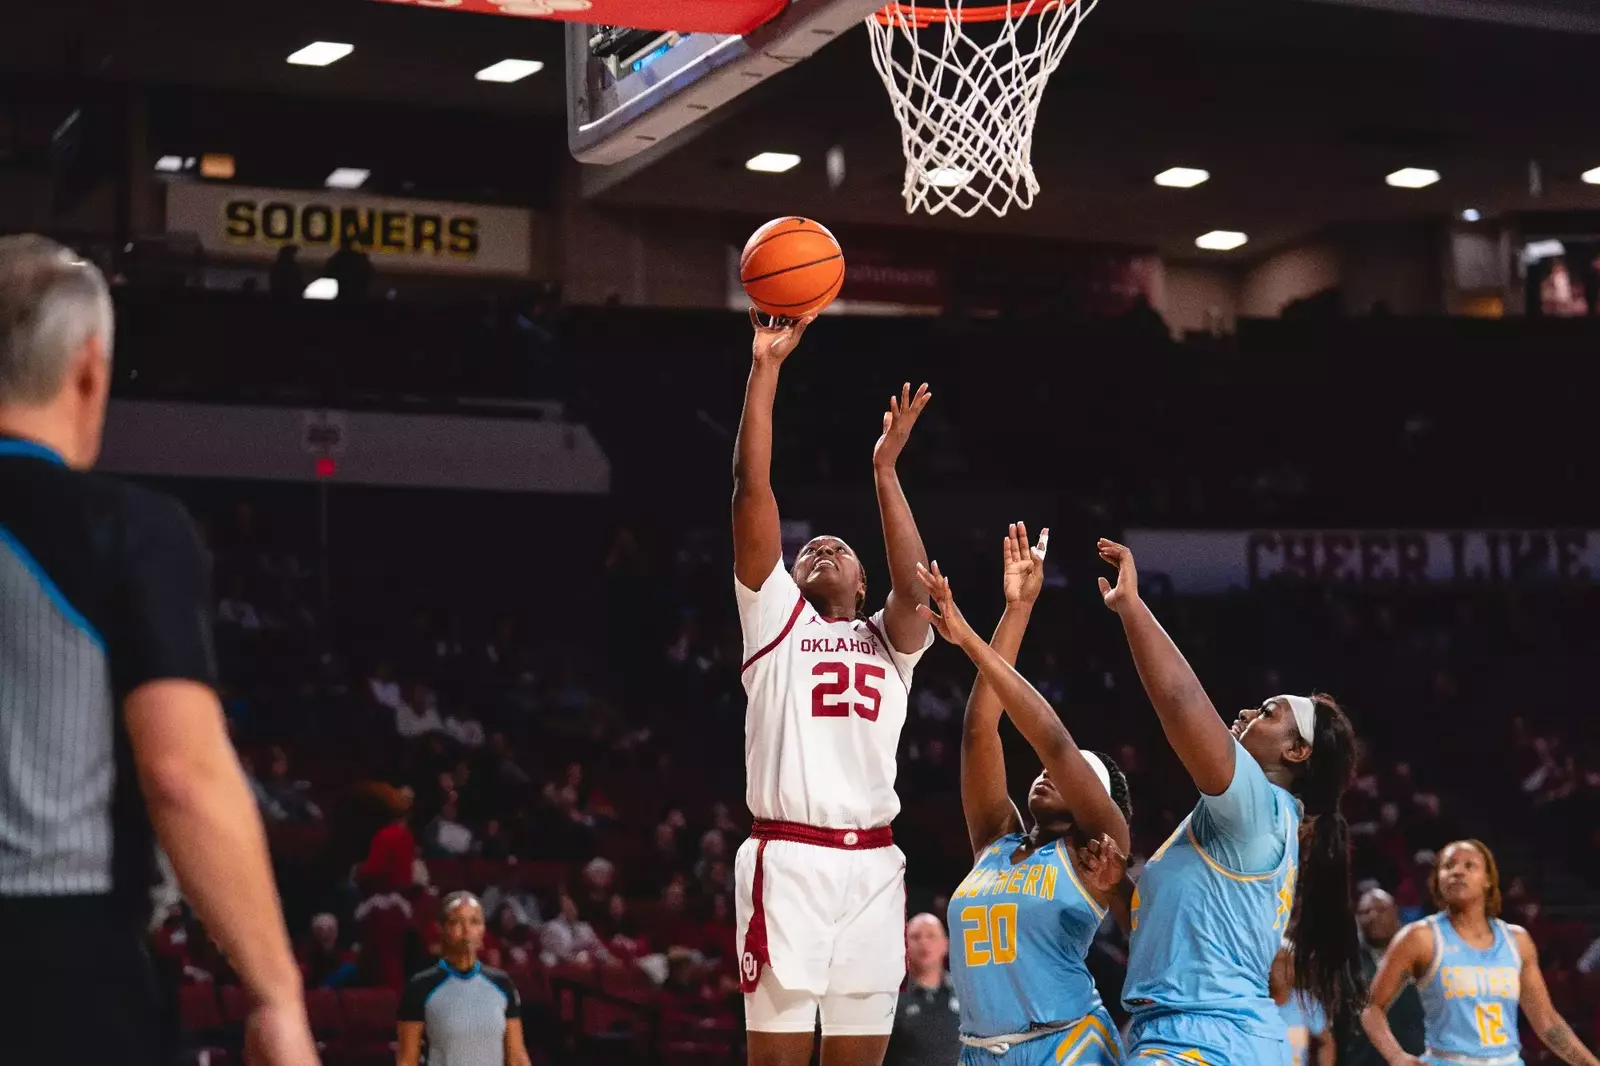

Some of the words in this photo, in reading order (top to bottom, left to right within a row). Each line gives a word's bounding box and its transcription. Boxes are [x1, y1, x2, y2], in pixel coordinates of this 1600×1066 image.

[225, 200, 480, 257] SOONERS
[1249, 531, 1429, 581] CHEER
[812, 661, 886, 722] 25
[961, 903, 1019, 968] 20
[1475, 1002, 1508, 1047] 12
